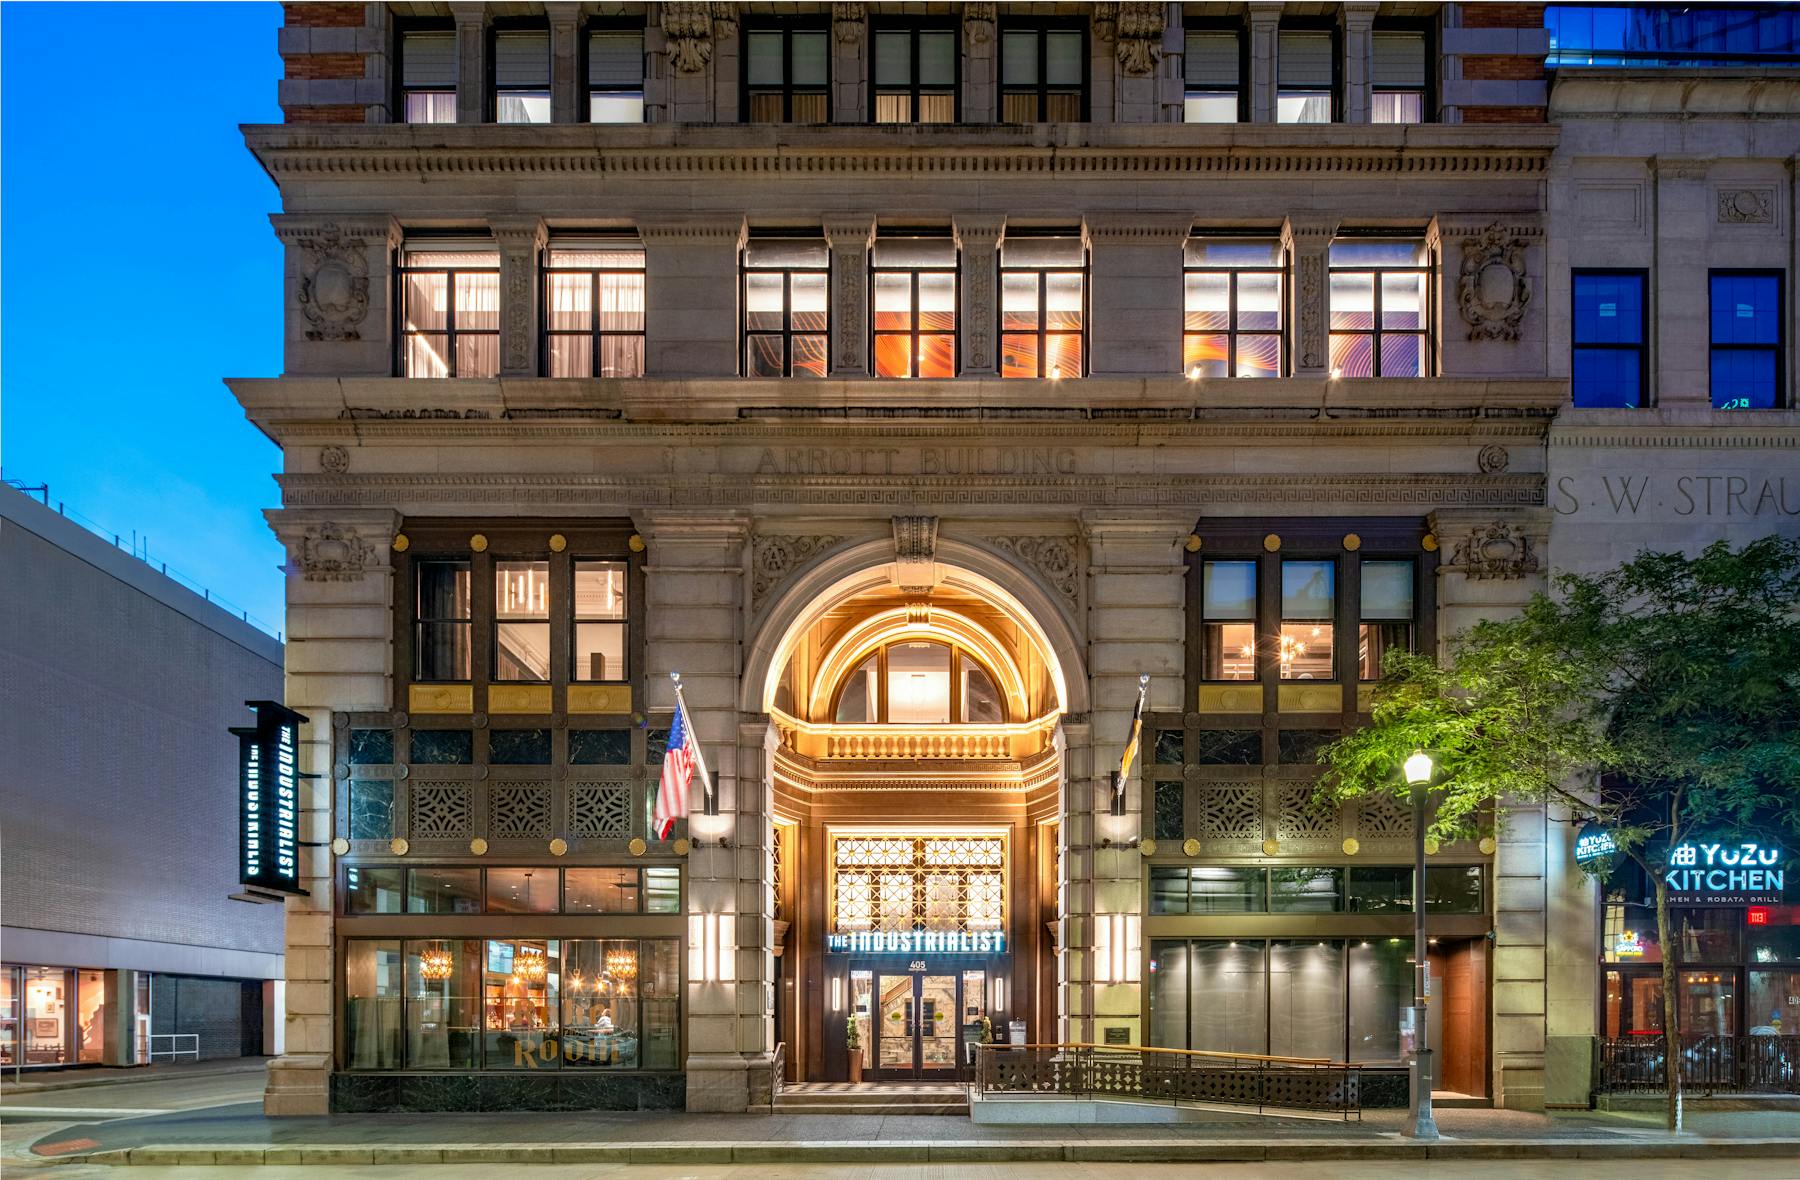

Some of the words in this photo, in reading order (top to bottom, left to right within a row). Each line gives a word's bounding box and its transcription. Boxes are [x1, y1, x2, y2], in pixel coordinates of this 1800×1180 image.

[756, 446, 901, 475] ARROTT
[919, 446, 1077, 475] BUILDING
[281, 725, 291, 744] THE
[278, 744, 294, 878] INDUSTRIALIST
[1665, 869, 1784, 891] KITCHEN
[828, 935, 848, 948] THE
[850, 931, 1004, 952] INDUSTRIALIST
[910, 960, 926, 969] 405
